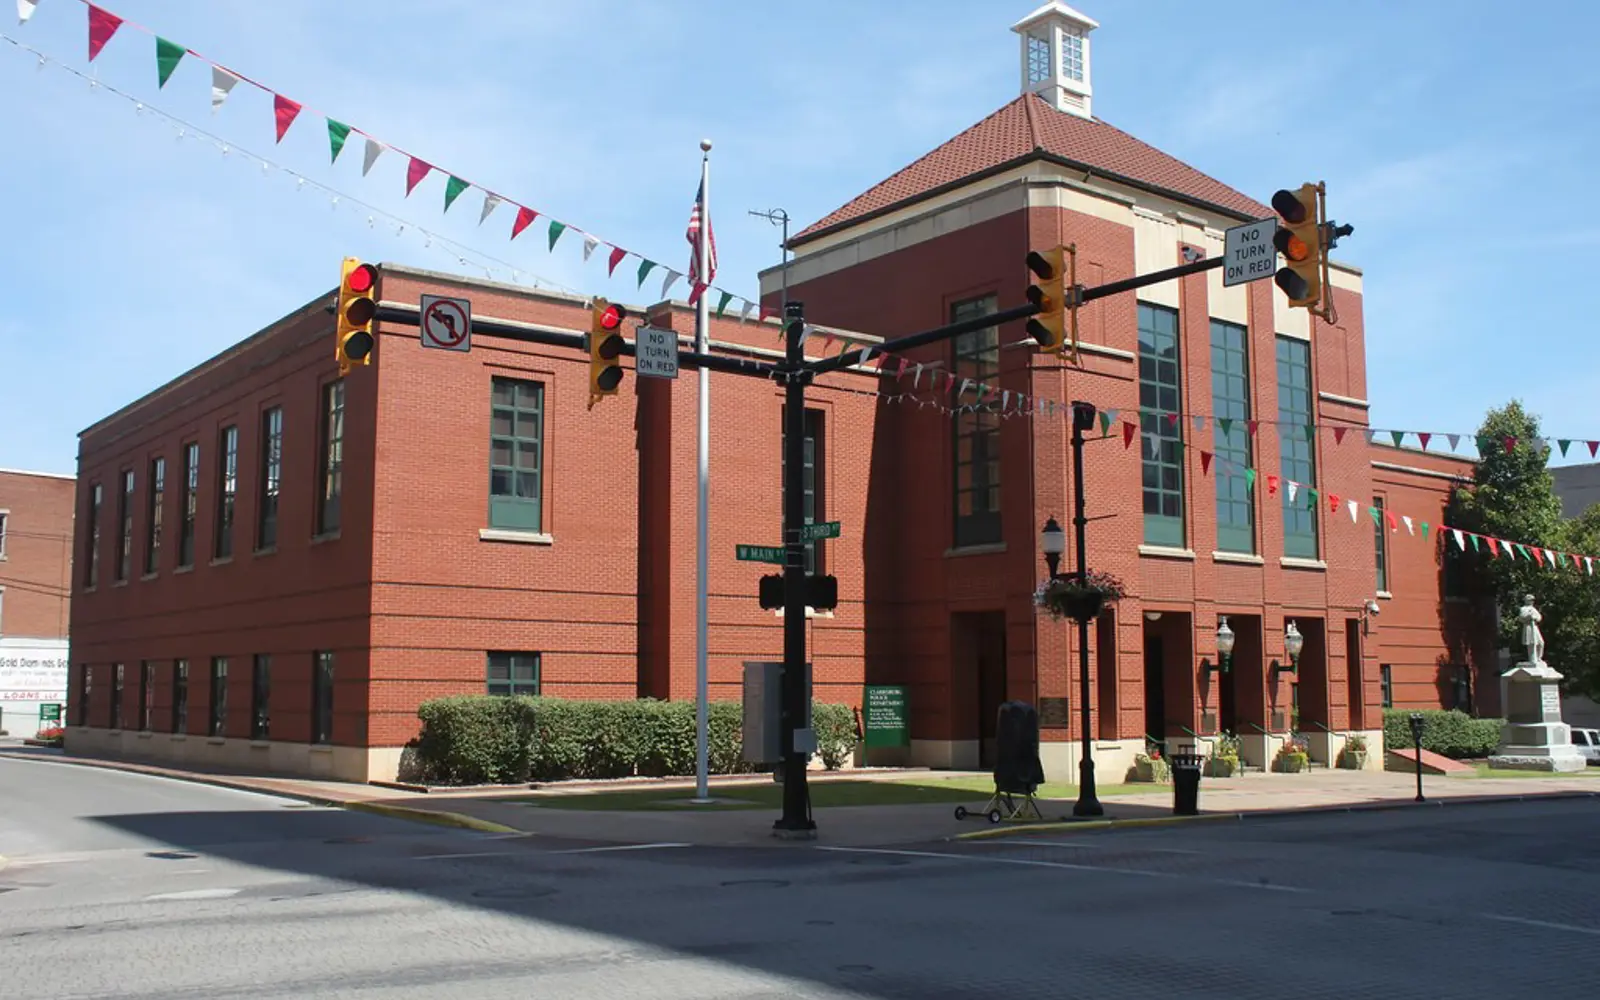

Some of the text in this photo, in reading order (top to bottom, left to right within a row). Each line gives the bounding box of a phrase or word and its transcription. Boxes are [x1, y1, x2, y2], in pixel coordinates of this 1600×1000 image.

[1241, 228, 1260, 243] NO
[1235, 244, 1266, 261] TURN
[1228, 259, 1272, 279] ON RED
[649, 333, 665, 344] NO
[645, 346, 670, 358] TURN
[640, 359, 675, 372] ON RED
[809, 524, 831, 538] THIRD
[739, 547, 748, 559] W
[750, 547, 775, 561] MAIN
